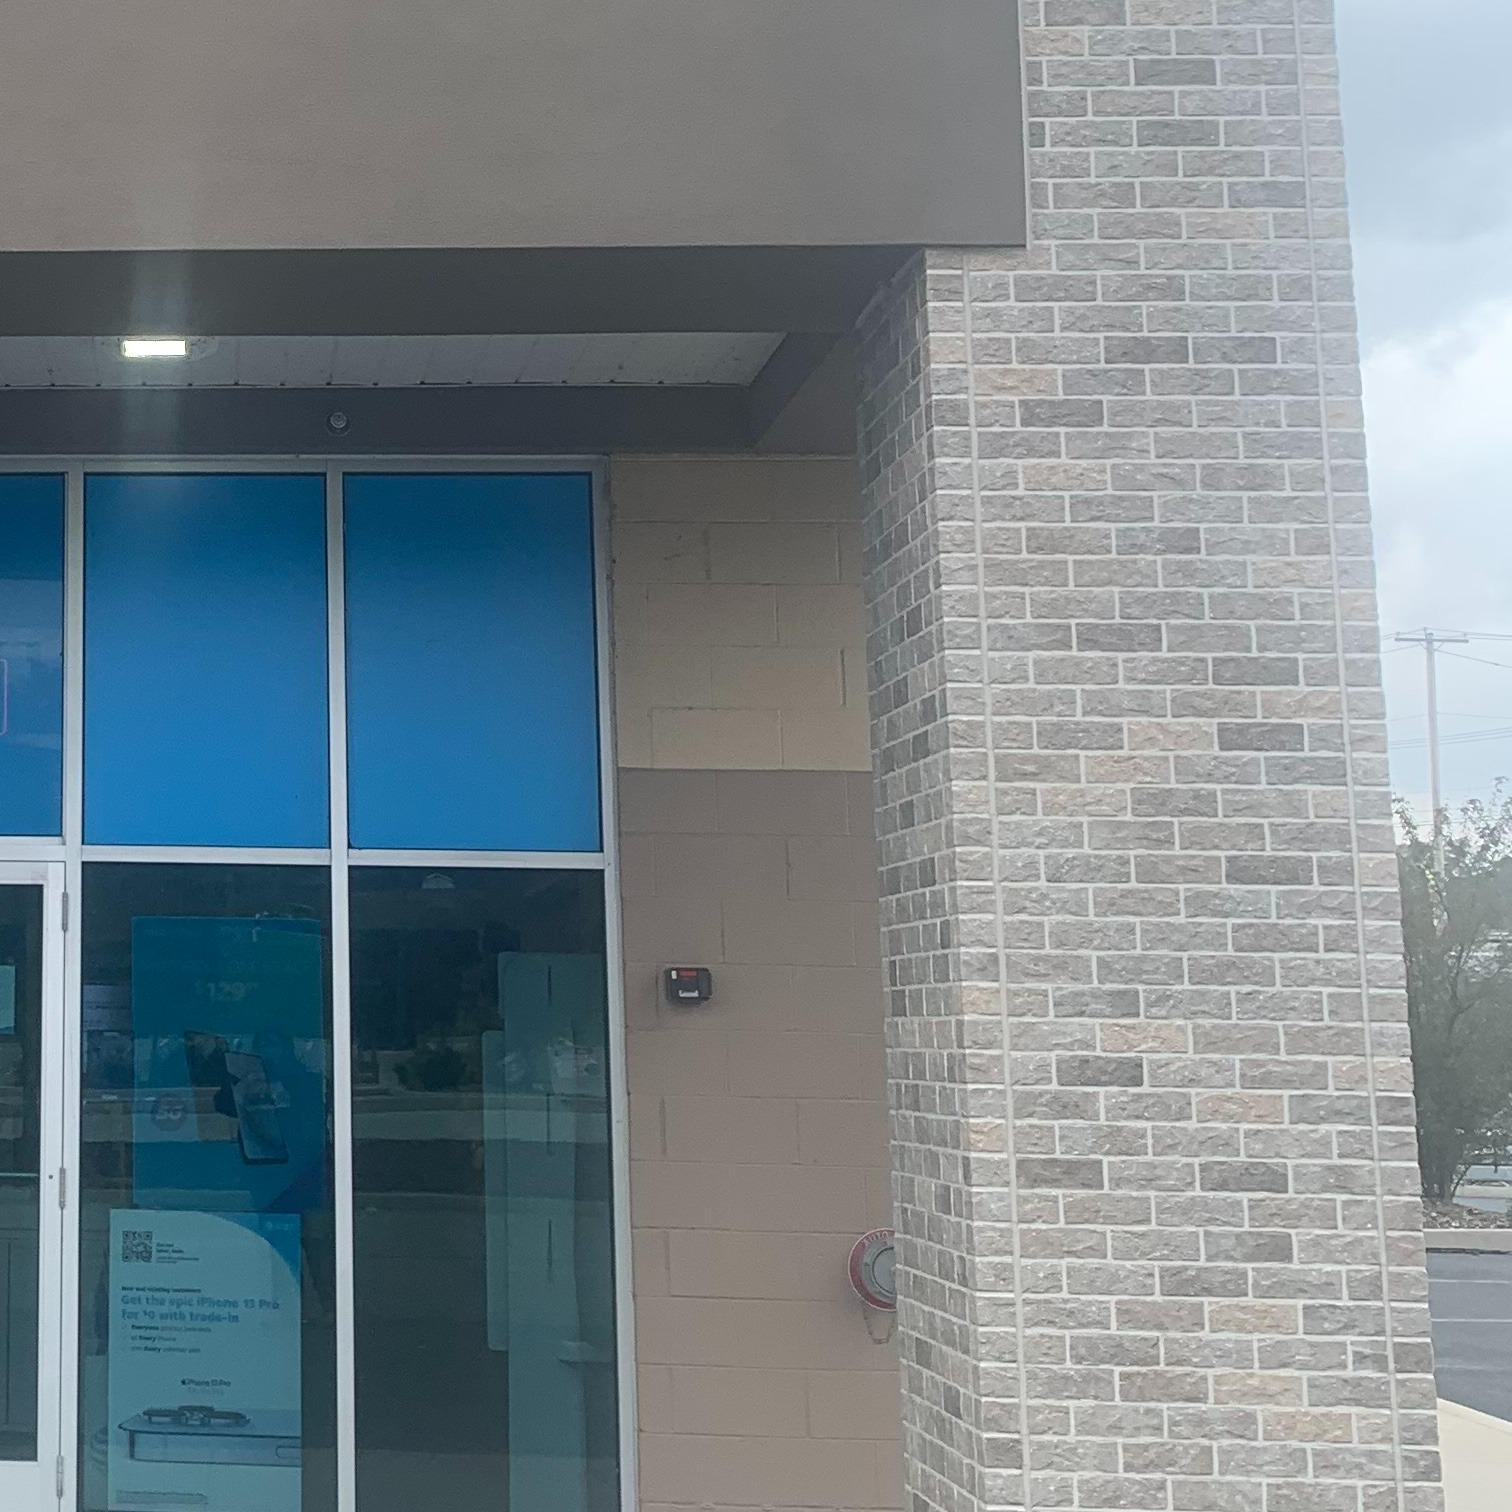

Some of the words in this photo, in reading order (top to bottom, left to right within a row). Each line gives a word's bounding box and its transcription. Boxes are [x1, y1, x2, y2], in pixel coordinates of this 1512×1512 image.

[121, 1294, 142, 1306] Get
[145, 1294, 166, 1306] the
[168, 1295, 194, 1309] epic
[196, 1296, 240, 1309] iPhone
[258, 1299, 281, 1310] Pro
[121, 1308, 139, 1320] for
[159, 1309, 187, 1321] with
[189, 1311, 240, 1323] trade-in
